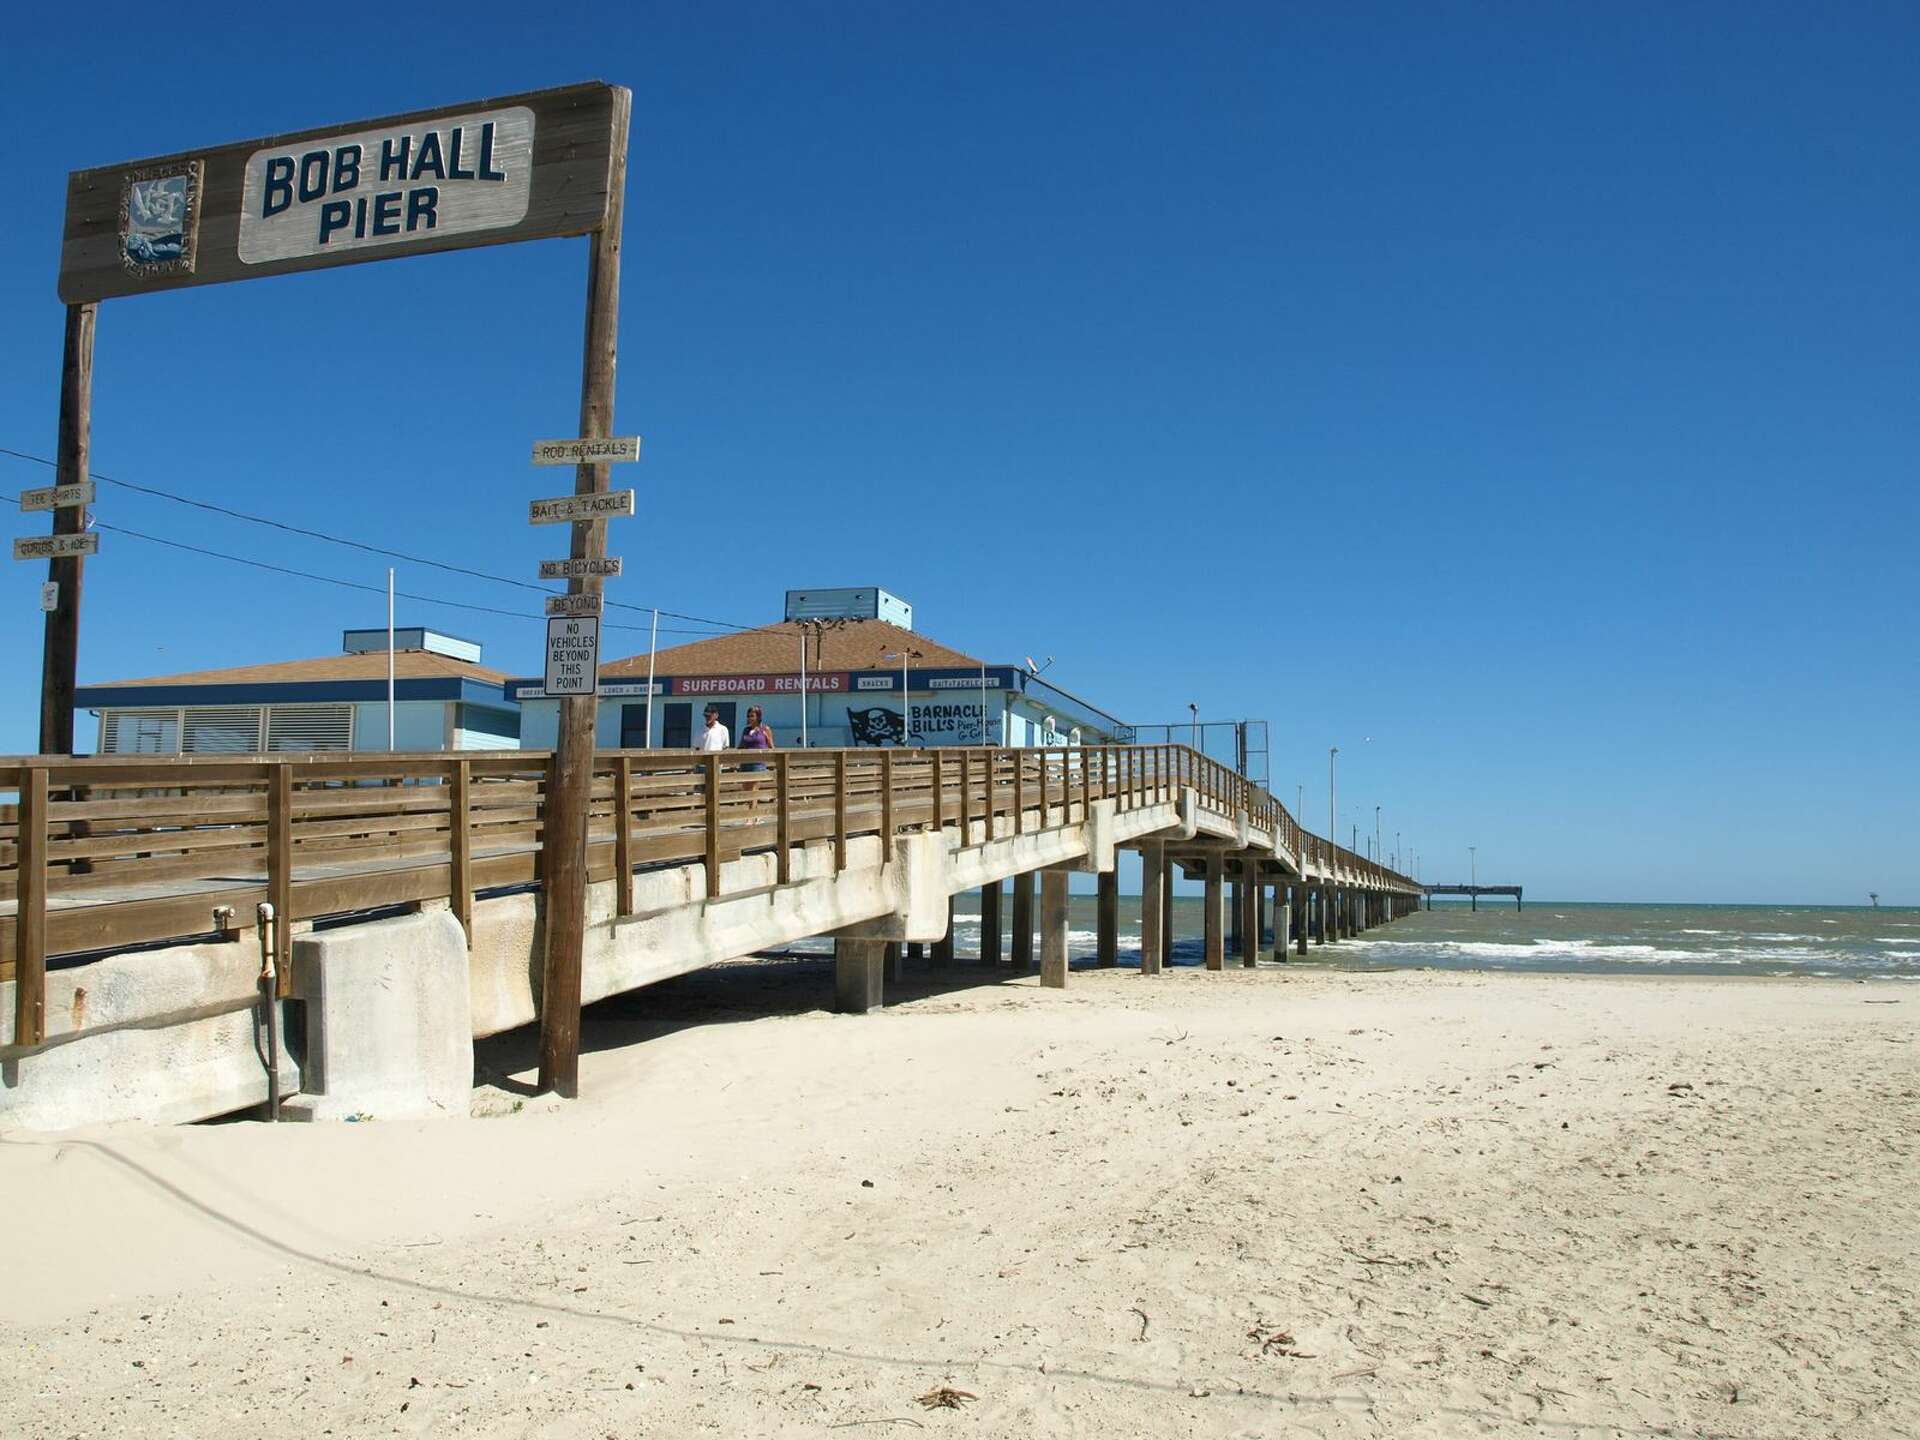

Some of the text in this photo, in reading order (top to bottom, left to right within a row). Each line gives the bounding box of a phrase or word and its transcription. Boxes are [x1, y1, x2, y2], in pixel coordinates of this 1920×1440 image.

[263, 122, 506, 219] BOB HALL
[318, 186, 441, 245] PIER
[542, 441, 628, 460] ROD RENTALS
[531, 496, 628, 518] BAIT & TACKLE
[541, 559, 620, 575] NO BICYCLES
[553, 597, 598, 611] BEYOND
[566, 623, 579, 634] NO
[551, 636, 595, 648] VEHICLES
[553, 650, 590, 662] BEYOND
[560, 663, 581, 675] THIS
[556, 677, 583, 689] POINT
[682, 677, 839, 692] SURFBOARD RENTALS
[910, 704, 988, 719] BARNACLE
[912, 719, 955, 733] BILL'S
